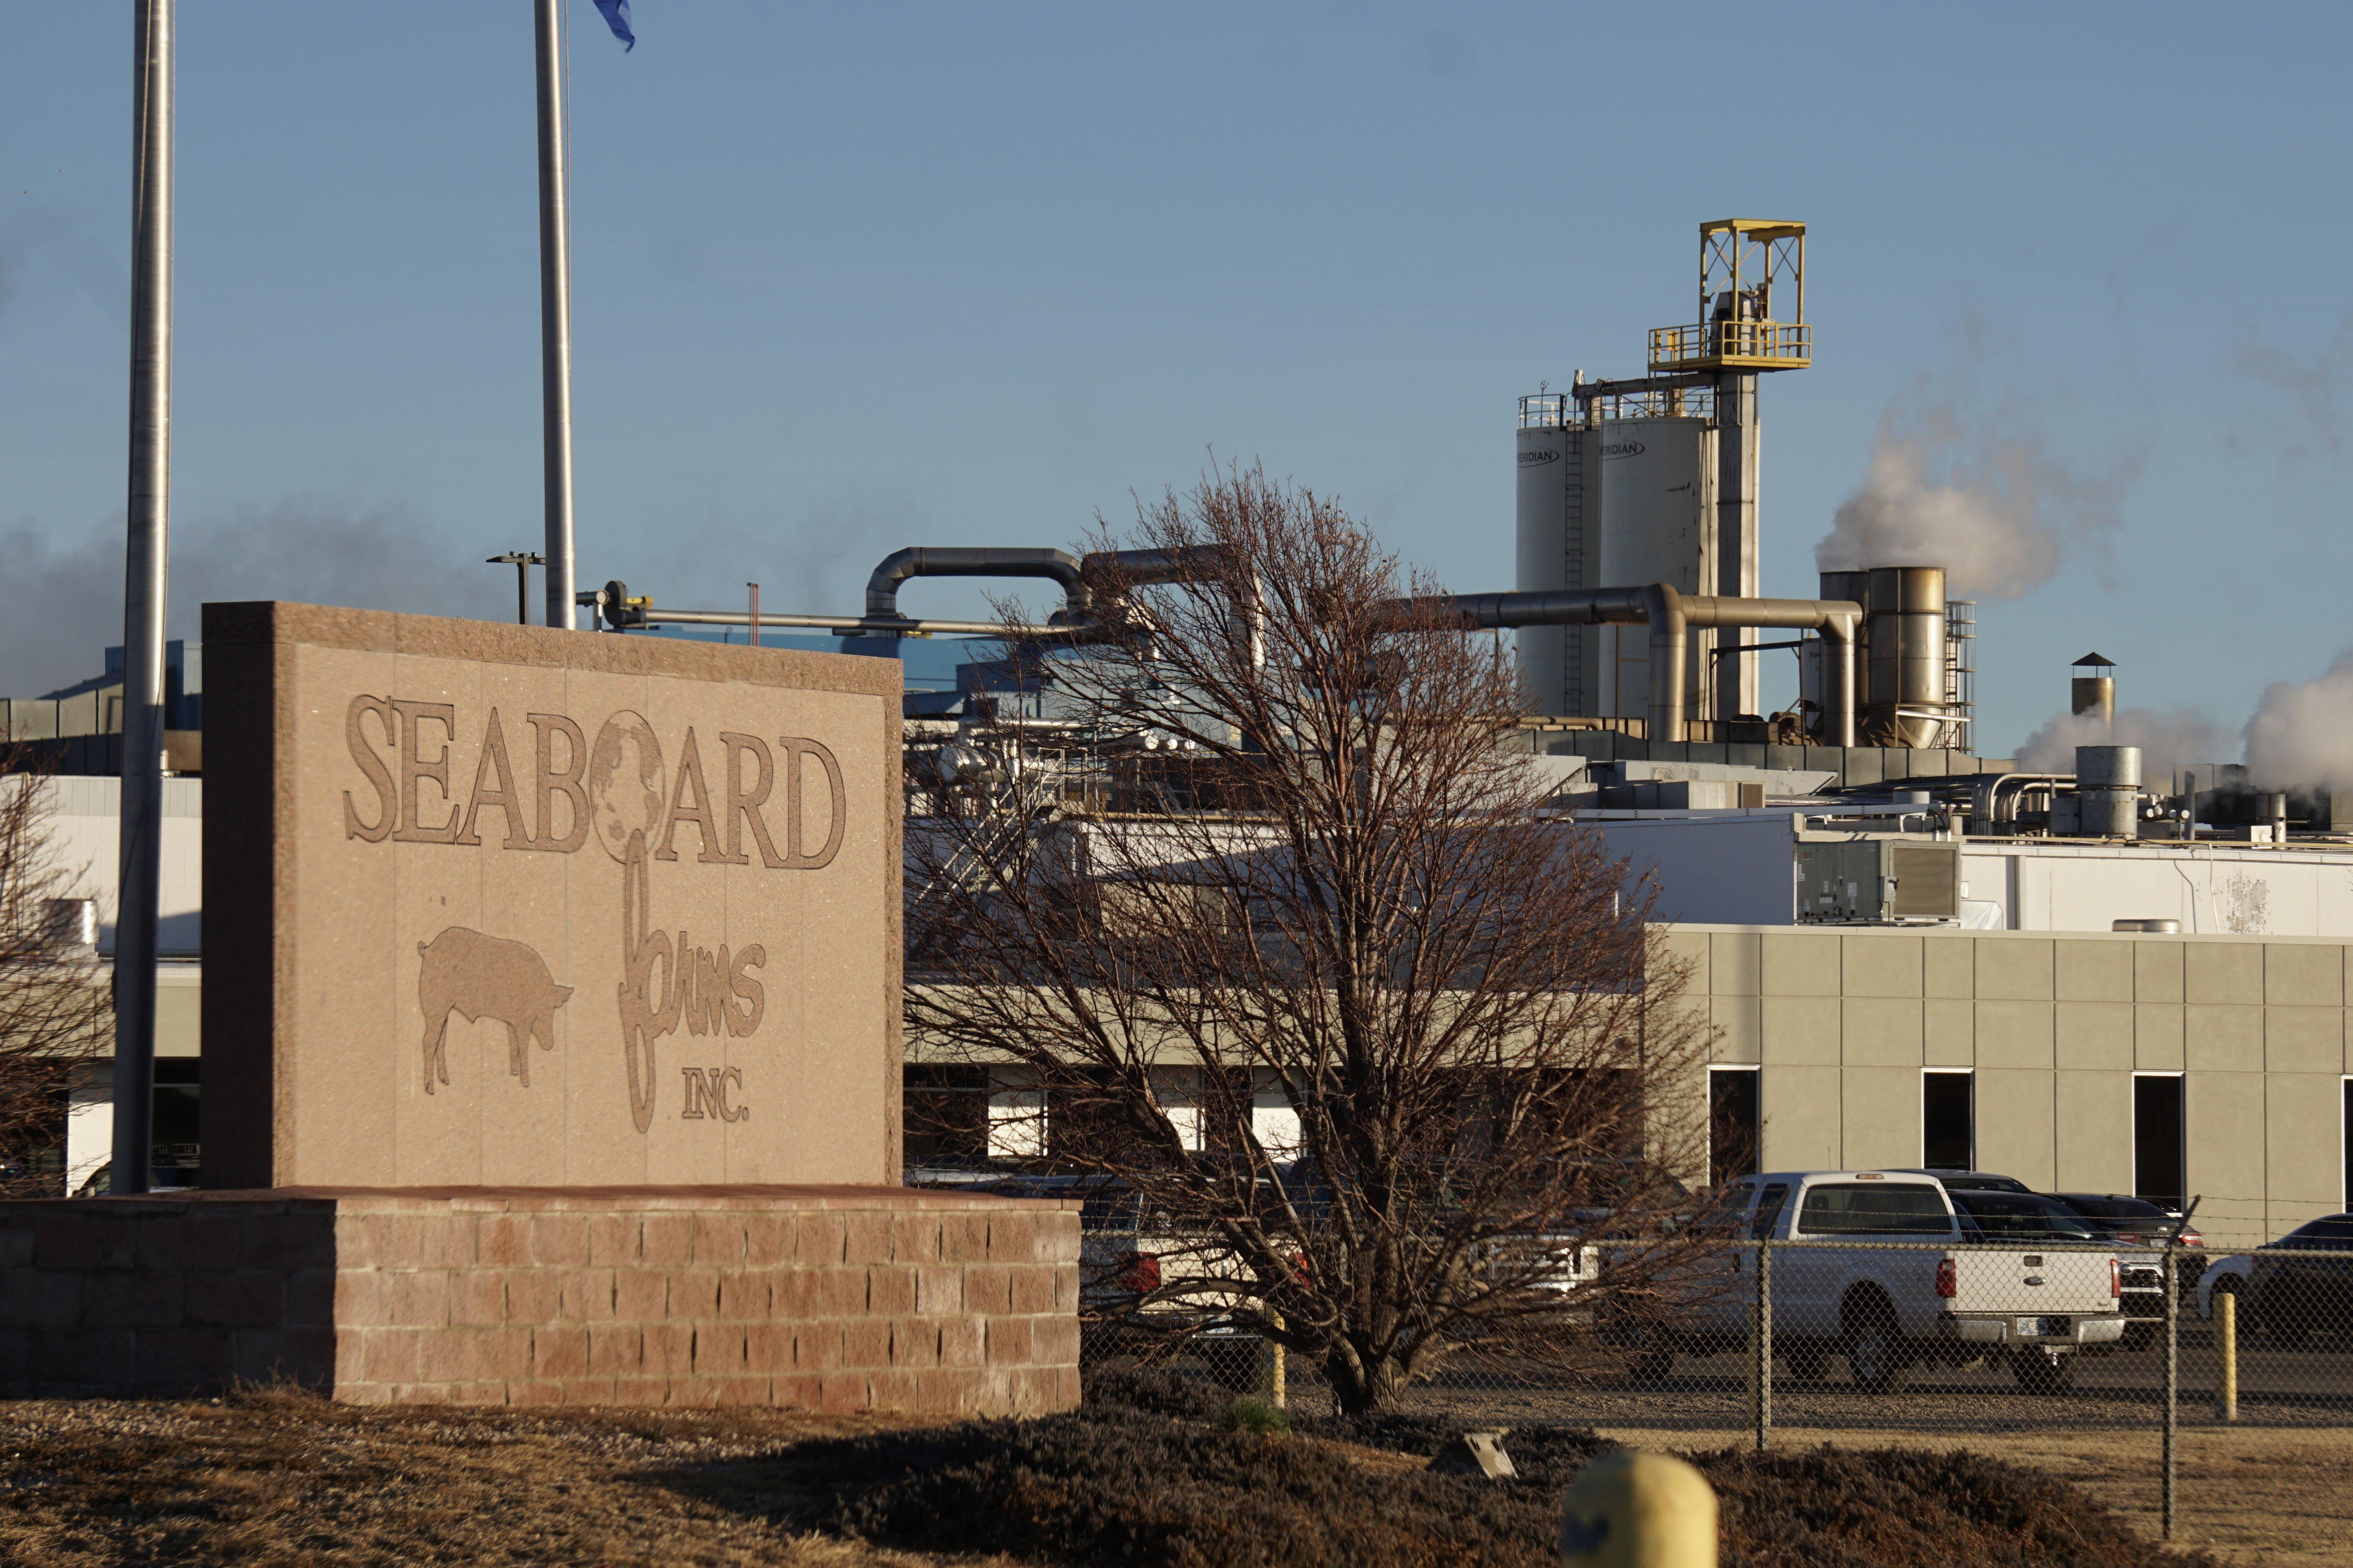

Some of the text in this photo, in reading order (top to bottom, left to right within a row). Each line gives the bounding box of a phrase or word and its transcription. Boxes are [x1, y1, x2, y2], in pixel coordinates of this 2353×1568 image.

[1518, 451, 1552, 463] ERIDIAN
[343, 693, 846, 870] SEABOARD
[682, 1066, 750, 1123] INC.
